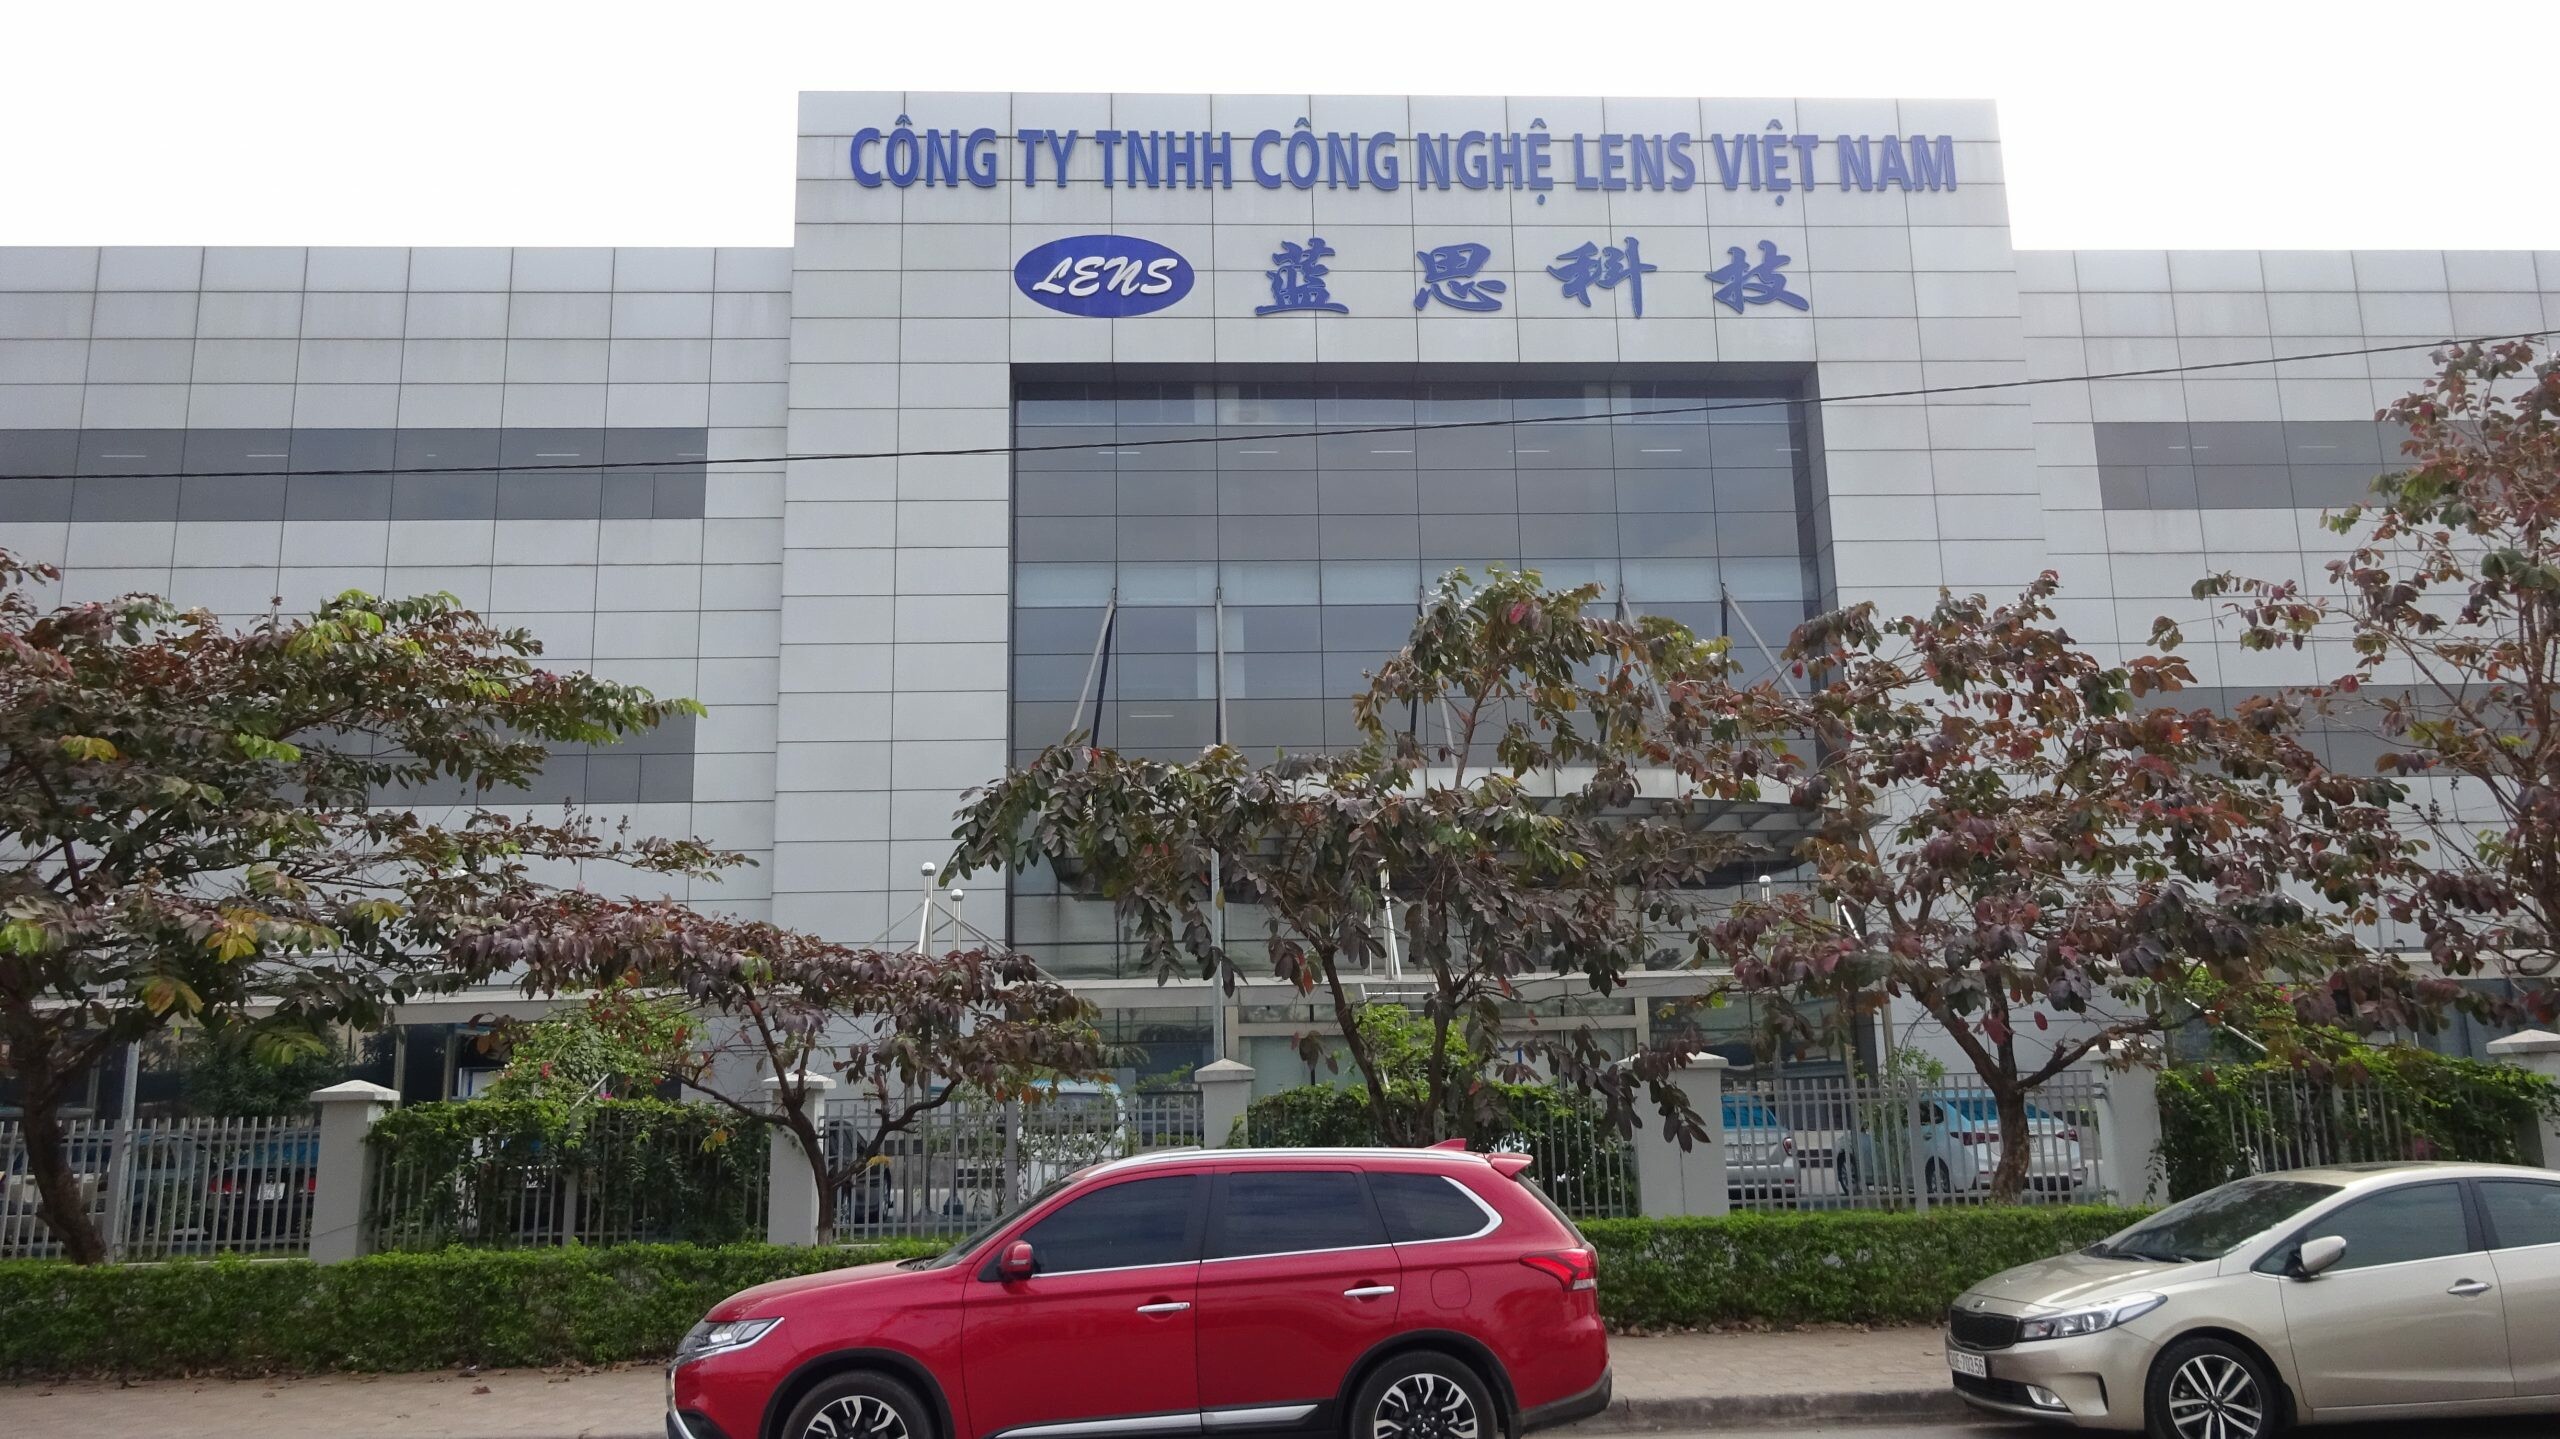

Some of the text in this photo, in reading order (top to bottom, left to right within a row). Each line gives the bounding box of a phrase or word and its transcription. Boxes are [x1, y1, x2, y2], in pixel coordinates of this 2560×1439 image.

[850, 114, 1957, 206] CÔNG TY TNHH CÔNG NGHỆ LENS VIỆT NAM
[1032, 256, 1178, 298] LENS
